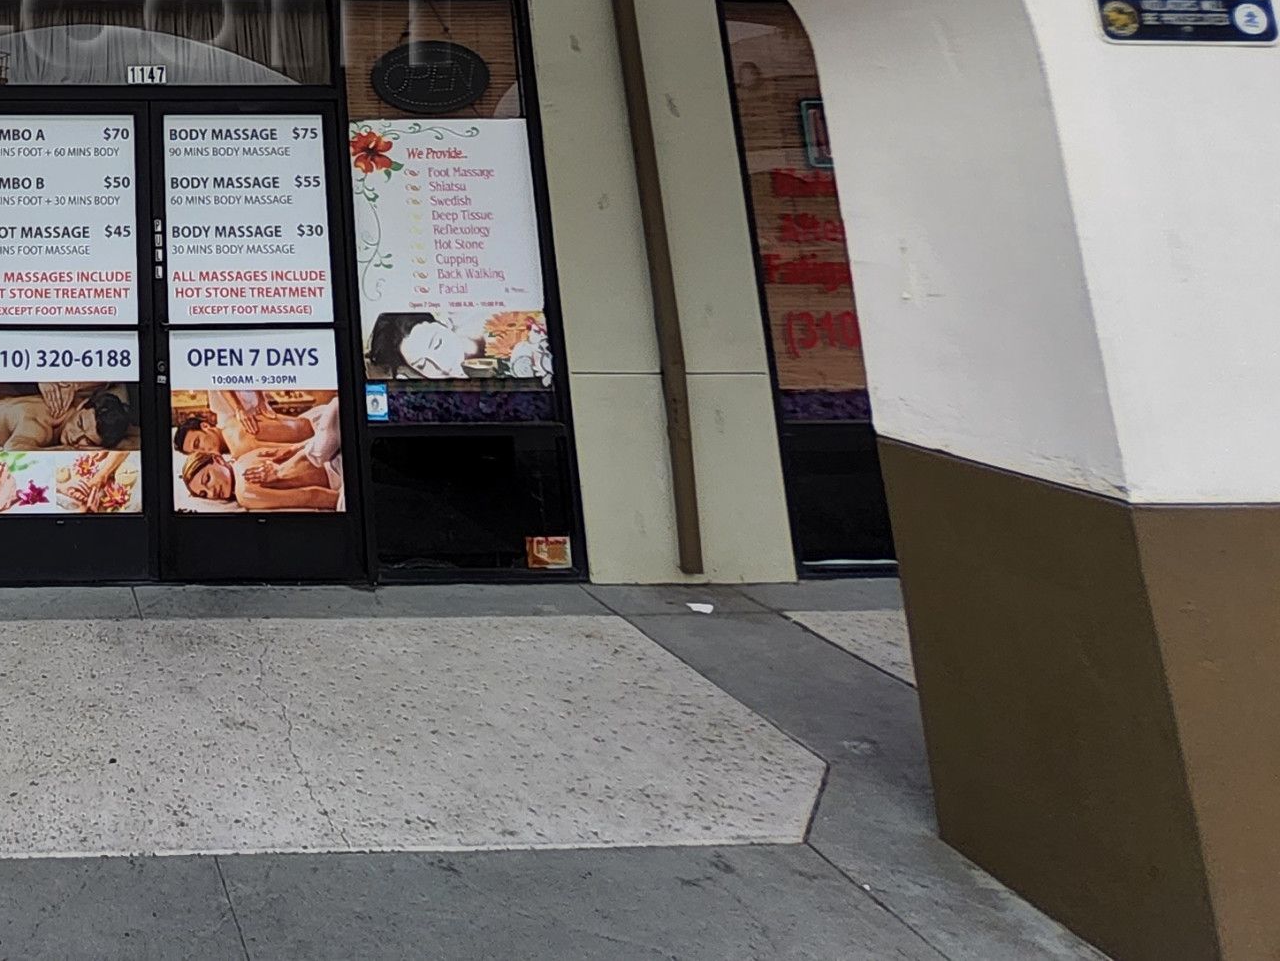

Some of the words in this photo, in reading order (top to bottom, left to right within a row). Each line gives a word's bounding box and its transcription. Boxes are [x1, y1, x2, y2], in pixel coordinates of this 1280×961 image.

[130, 66, 165, 84] 1147
[384, 61, 474, 94] OPEN
[36, 129, 45, 141] A
[103, 127, 129, 140] $70
[169, 129, 208, 141] BODY
[211, 129, 277, 140] MASSAGE
[293, 127, 318, 140] $75
[18, 147, 43, 156] FOOT
[54, 147, 65, 156] 60
[68, 147, 91, 156] MINS
[94, 147, 119, 156] BODY
[169, 147, 181, 156] 90
[184, 147, 209, 156] MINS
[213, 147, 239, 156] BODY
[243, 147, 290, 156] MASSAGE
[406, 148, 423, 159] We
[428, 167, 449, 177] Foot
[453, 167, 495, 179] Massage
[36, 178, 45, 189] B
[104, 176, 130, 189] $50
[171, 177, 209, 189] BODY
[213, 177, 280, 188] MASSAGE
[294, 175, 320, 188] $55
[429, 181, 466, 192] Shiatsu
[18, 196, 43, 205] FOOT
[54, 196, 66, 205] 30
[68, 196, 92, 205] MINS
[95, 196, 120, 205] BODY
[171, 195, 183, 205] 60
[185, 195, 211, 205] MINS
[214, 195, 241, 205] BODY
[244, 195, 292, 205] MASSAGE
[430, 195, 471, 206] Swedish
[432, 210, 458, 222] Deep
[461, 210, 494, 220] Tissue
[21, 227, 90, 238] MASSAGE
[105, 225, 131, 238] $45
[172, 226, 210, 238] BODY
[215, 226, 282, 237] MASSAGE
[297, 224, 323, 237] $30
[433, 224, 490, 237] Reflexology
[172, 245, 184, 254] 30
[187, 245, 213, 254] MINS
[216, 245, 244, 254] BODY
[246, 245, 295, 254] MASSAGE
[435, 239, 451, 250] Hot
[455, 239, 484, 250] Stone
[18, 246, 43, 255] FOOT
[46, 246, 90, 255] MASSAGE
[436, 254, 479, 267] Cupping
[4, 272, 73, 283] MASSAGES
[77, 272, 131, 283] INCLUDE
[173, 271, 195, 282] ALL
[199, 271, 267, 282] MASSAGES
[271, 271, 326, 282] INCLUDE
[438, 269, 462, 279] Back
[466, 269, 505, 281] Walking
[9, 288, 51, 299] STONE
[55, 288, 130, 299] TREATMENT
[175, 287, 202, 298] HOT
[205, 287, 246, 298] STONE
[249, 287, 325, 298] TREATMENT
[439, 283, 468, 294] Facial
[36, 307, 63, 316] FOOT
[65, 307, 117, 316] MASSAGE)
[189, 305, 229, 315] (EXCEPT
[231, 305, 258, 315] FOOT
[261, 305, 312, 315] MASSAGE)
[36, 348, 132, 368] 320-6188
[187, 348, 242, 367] OPEN
[249, 348, 259, 367] 7
[266, 348, 319, 366] DAYS
[211, 375, 254, 385] 10:00AM
[261, 374, 297, 384] 9:30PM
